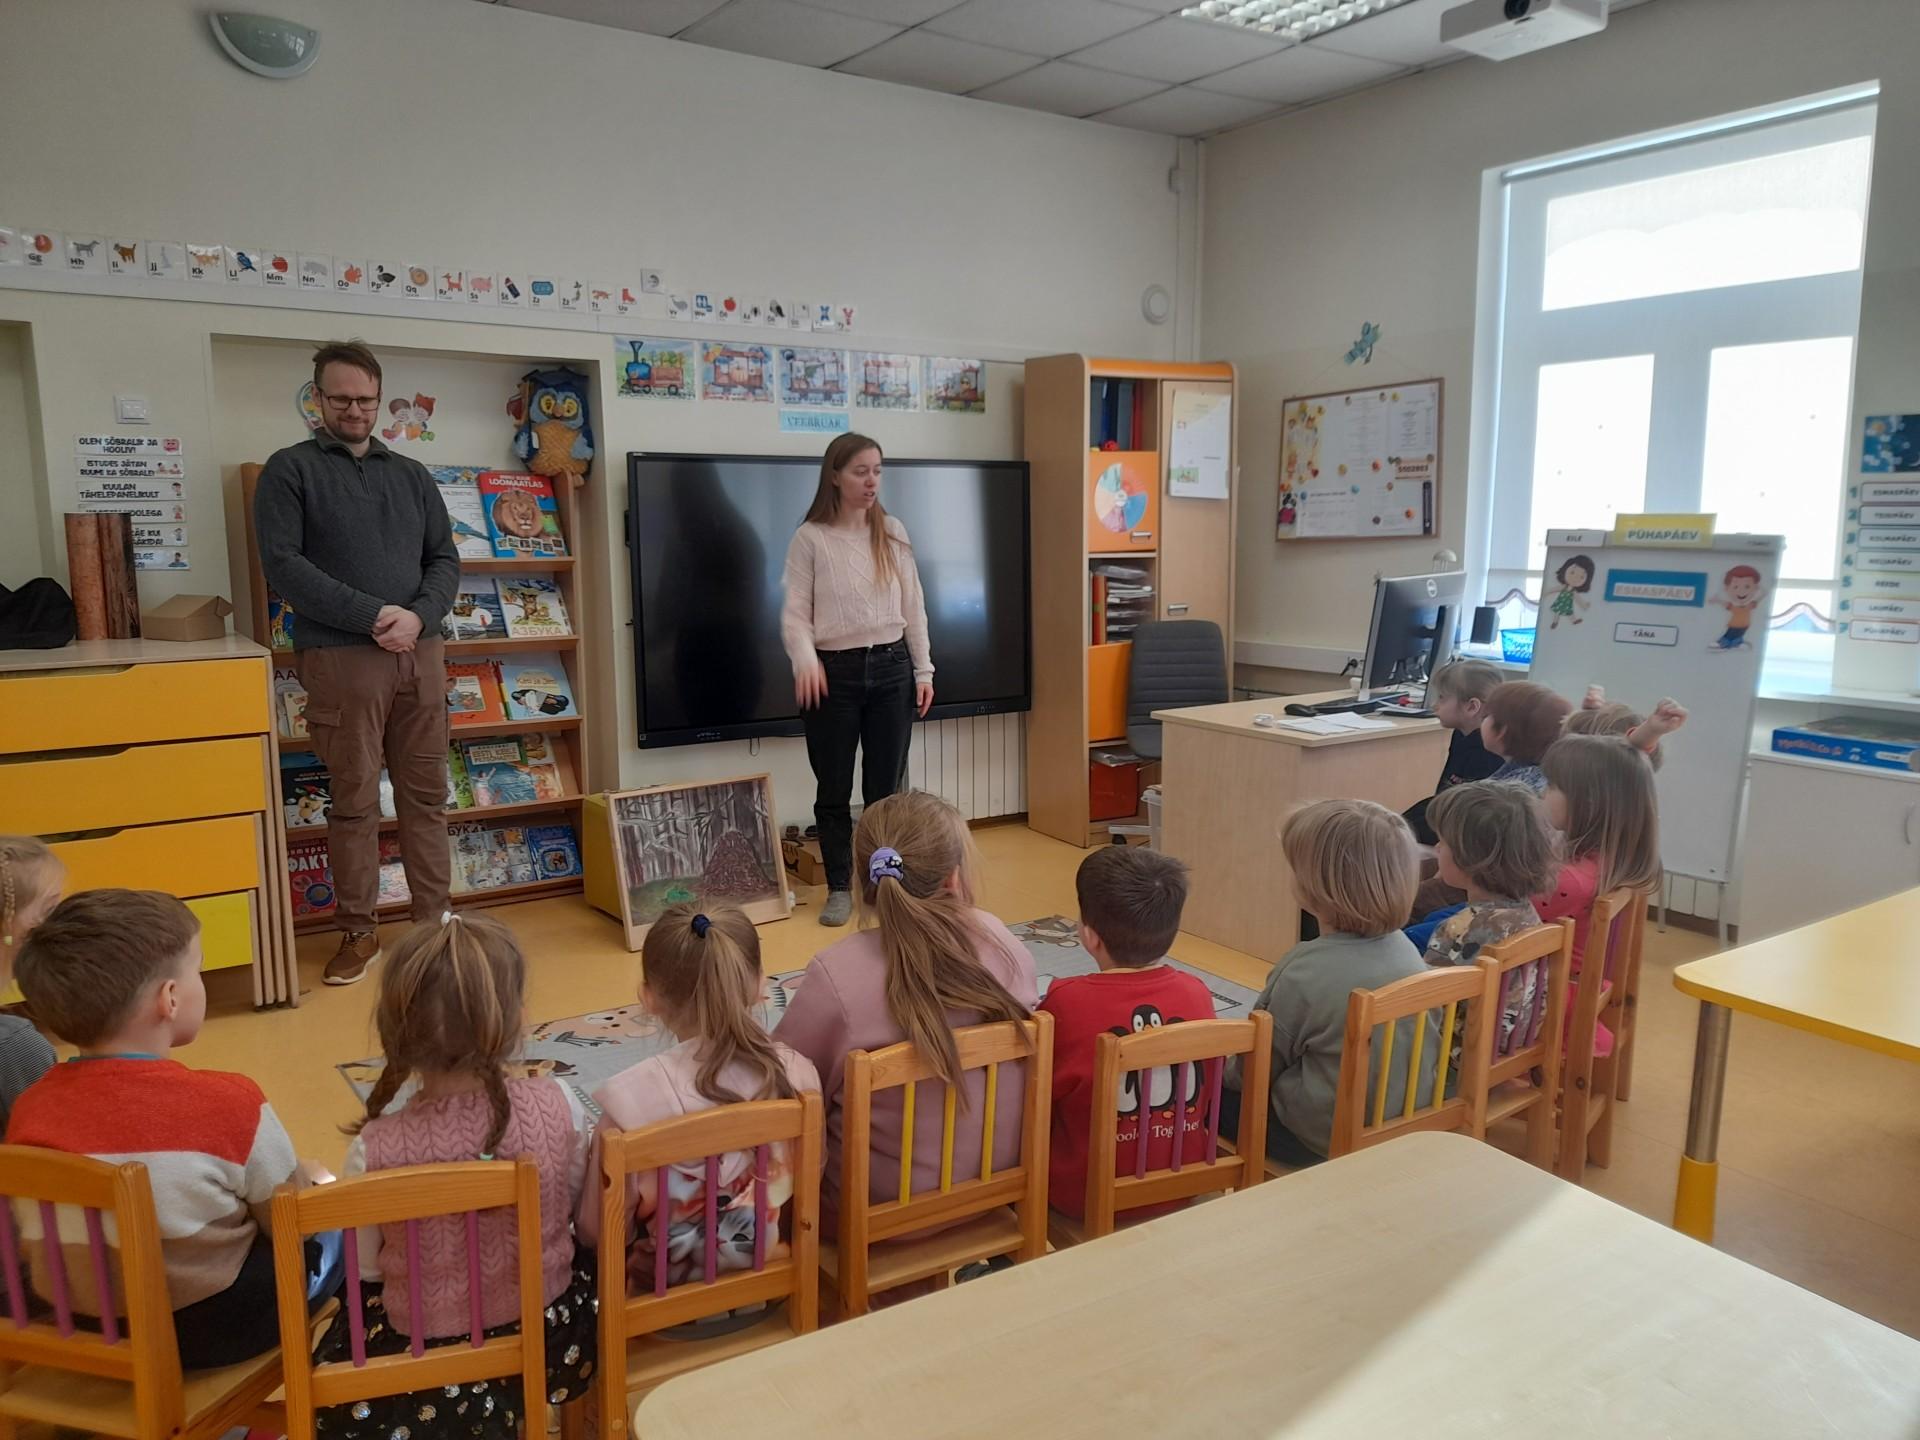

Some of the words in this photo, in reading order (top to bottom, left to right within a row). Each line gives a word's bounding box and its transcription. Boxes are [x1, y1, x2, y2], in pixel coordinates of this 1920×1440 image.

[28, 252, 42, 262] Gg
[70, 258, 85, 266] Hh
[150, 262, 158, 272] Jj
[192, 267, 204, 275] Kk
[266, 273, 284, 282] Mm
[302, 275, 316, 283] Nn
[337, 280, 350, 288] Oo
[371, 281, 383, 290] Pp
[405, 285, 418, 294] Qq
[104, 436, 144, 446] SÕBRALIK
[1627, 529, 1698, 541] PÜHAPÄEV
[1843, 554, 1854, 566] 4
[1842, 576, 1852, 588] 5
[1615, 584, 1694, 599] ESMASPÄEV
[1840, 599, 1850, 612] 6
[512, 626, 562, 636] АЗБУКА
[1839, 622, 1849, 634] 7
[1632, 629, 1656, 638] TÄNA
